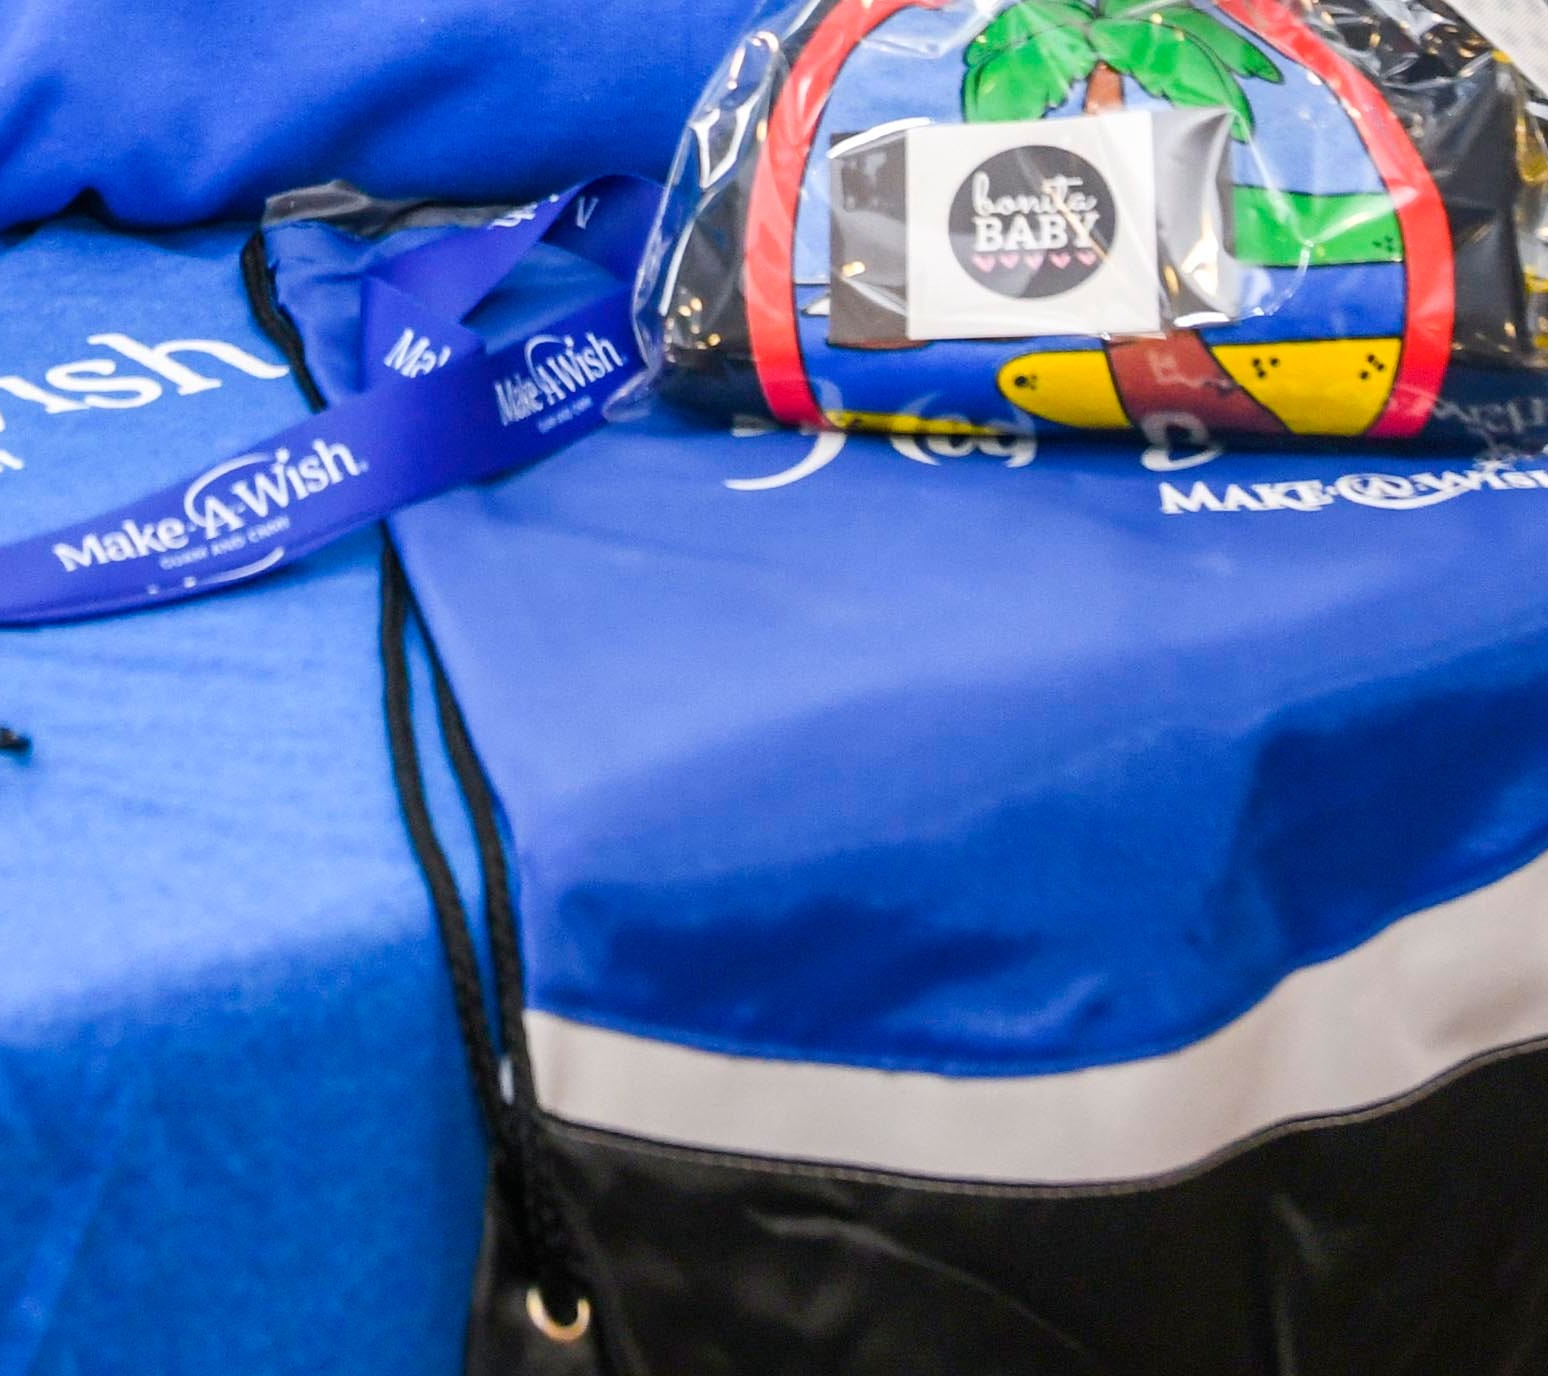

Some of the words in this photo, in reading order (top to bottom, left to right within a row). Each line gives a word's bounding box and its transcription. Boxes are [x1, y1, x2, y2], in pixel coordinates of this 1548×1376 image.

[972, 170, 1098, 217] bonita
[971, 210, 1101, 252] BABY
[52, 437, 362, 572] Make-A-Wish
